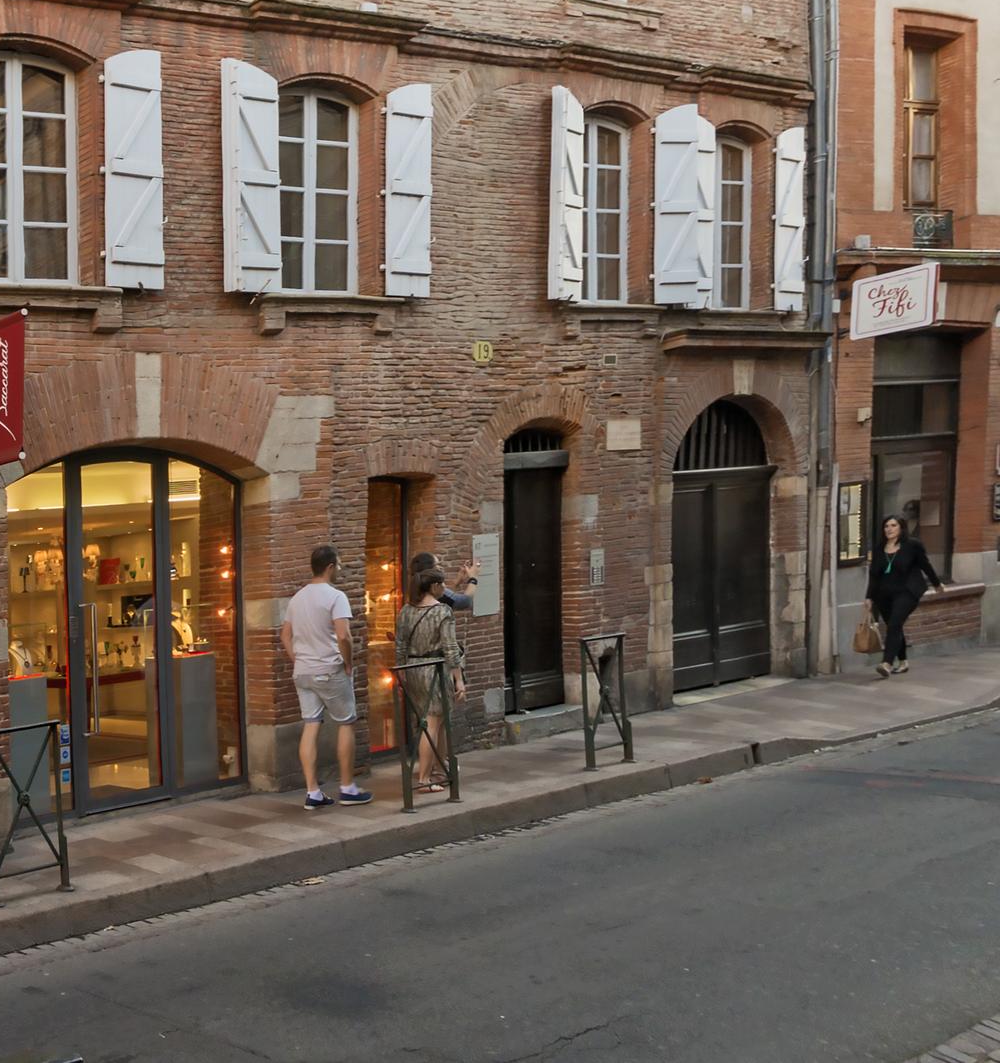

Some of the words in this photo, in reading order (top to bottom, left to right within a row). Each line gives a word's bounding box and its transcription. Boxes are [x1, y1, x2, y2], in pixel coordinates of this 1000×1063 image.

[867, 284, 907, 300] Chez
[872, 289, 917, 318] Fifi
[478, 343, 489, 359] 19
